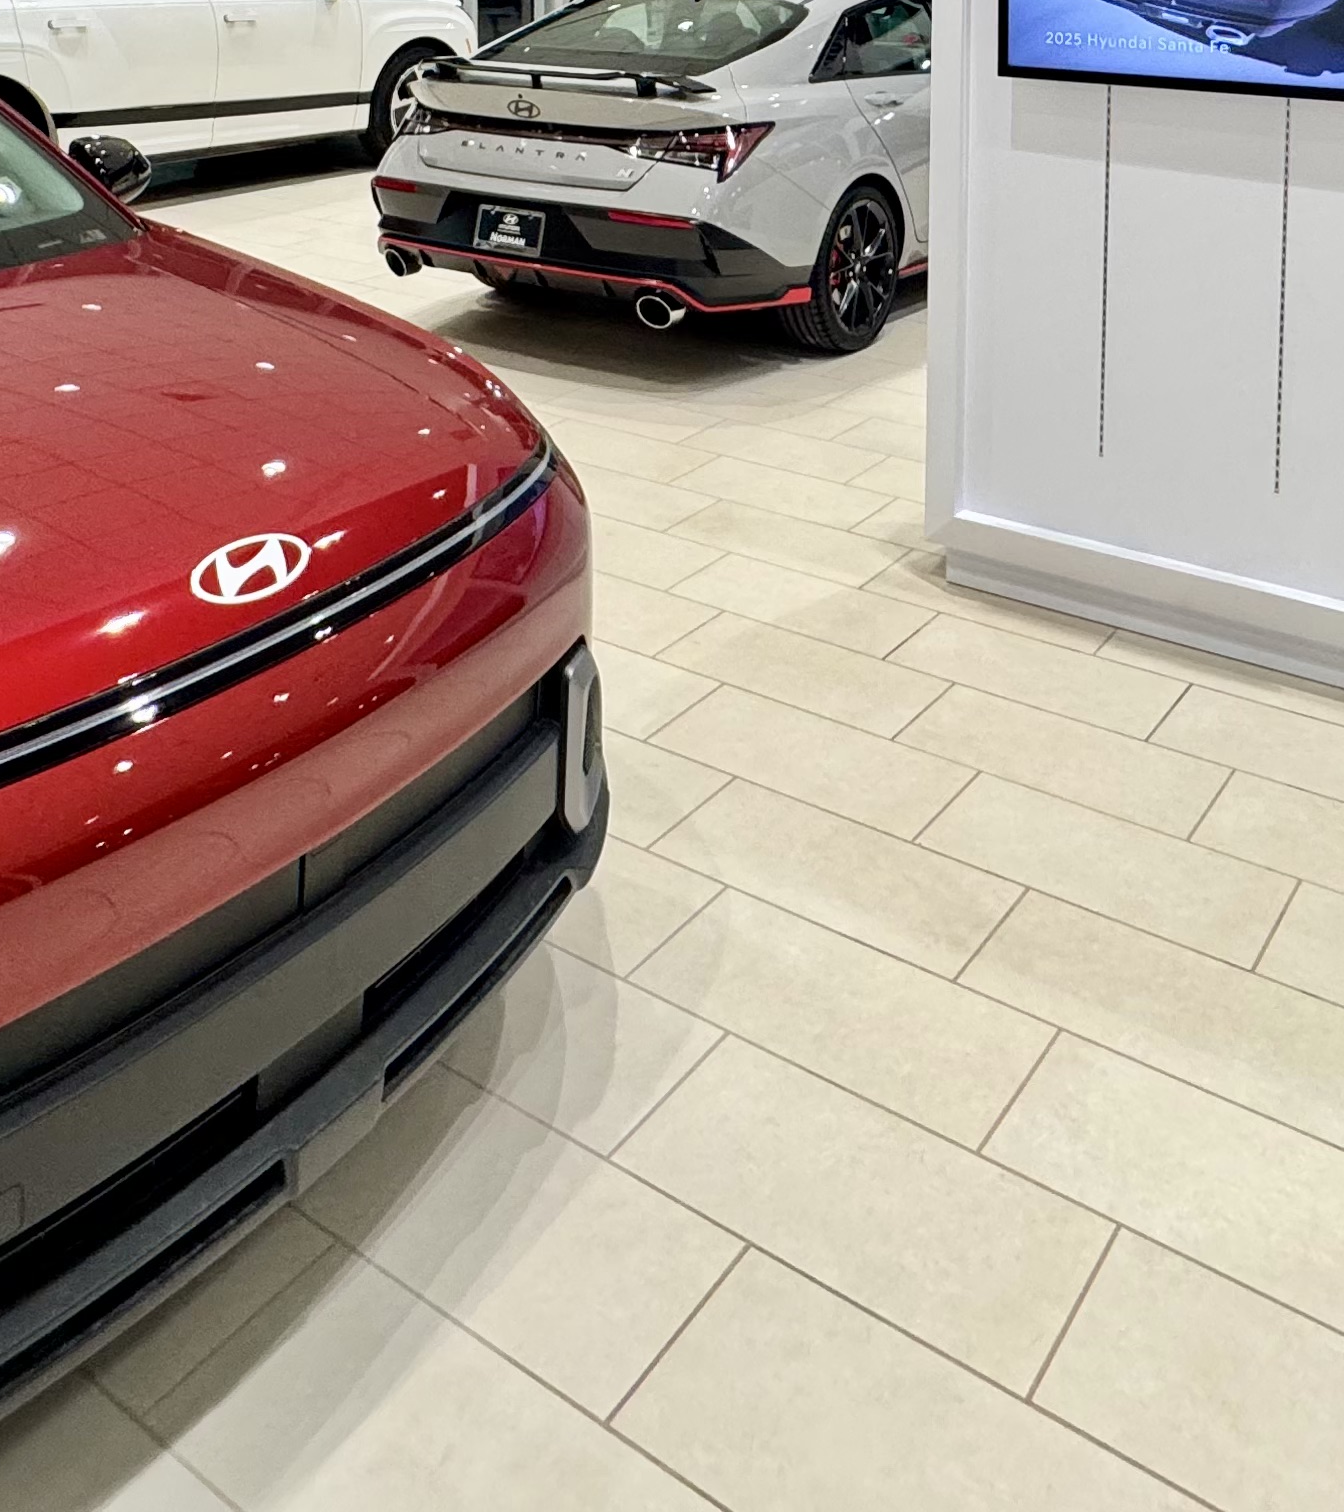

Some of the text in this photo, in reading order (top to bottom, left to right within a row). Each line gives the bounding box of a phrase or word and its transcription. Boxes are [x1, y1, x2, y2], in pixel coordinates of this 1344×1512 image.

[1045, 31, 1230, 54] 2025 Hyundai Santa Fe
[460, 140, 586, 161] ELANTRA
